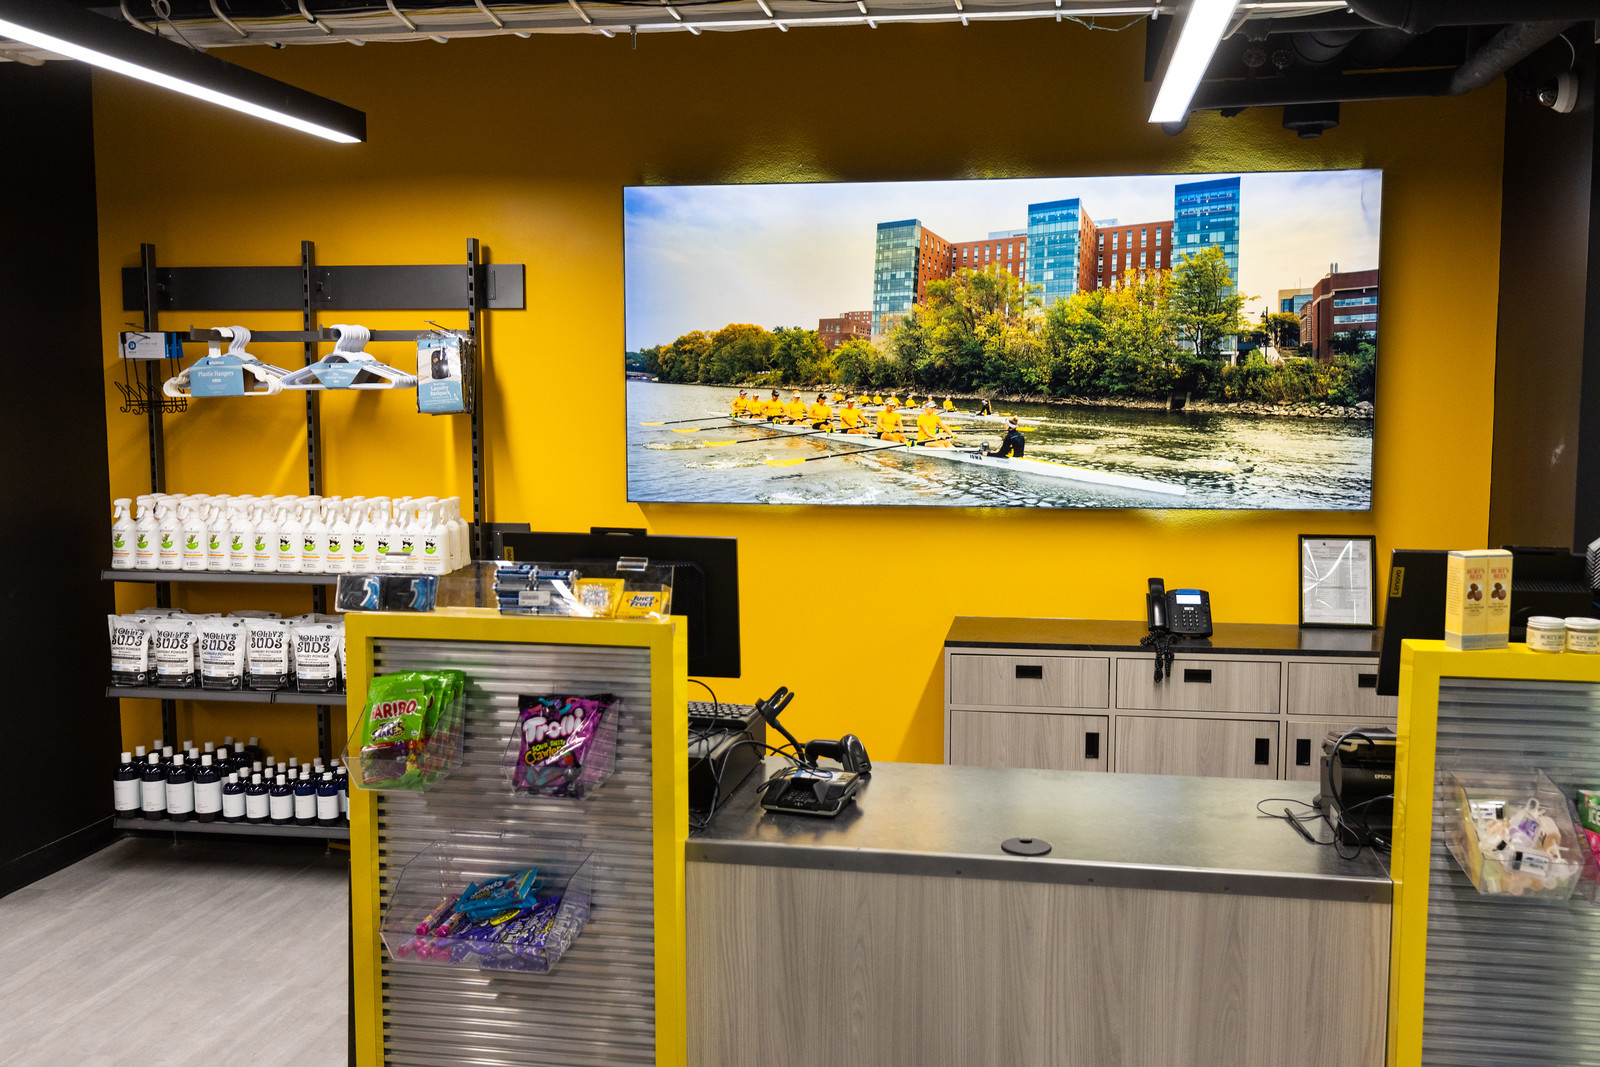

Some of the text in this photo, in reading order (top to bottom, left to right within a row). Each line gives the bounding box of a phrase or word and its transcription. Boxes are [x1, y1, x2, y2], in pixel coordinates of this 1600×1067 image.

[214, 370, 234, 378] Hangers
[1391, 569, 1402, 595] Lenovo
[360, 578, 376, 607] 5
[407, 578, 420, 608] 5
[112, 627, 145, 637] MOLLY'S
[156, 630, 190, 639] MOLLY'S
[202, 632, 237, 641] MOLLY'S
[250, 630, 285, 639] MOLLY'S
[297, 634, 331, 642] MOLLY'S
[111, 634, 143, 647] SUDS
[155, 637, 189, 649] SUDS
[201, 639, 236, 652] SUDS
[250, 637, 283, 649] SUDS
[296, 641, 330, 653] SUDS
[522, 707, 584, 743] Trolli
[531, 742, 548, 752] SOUR
